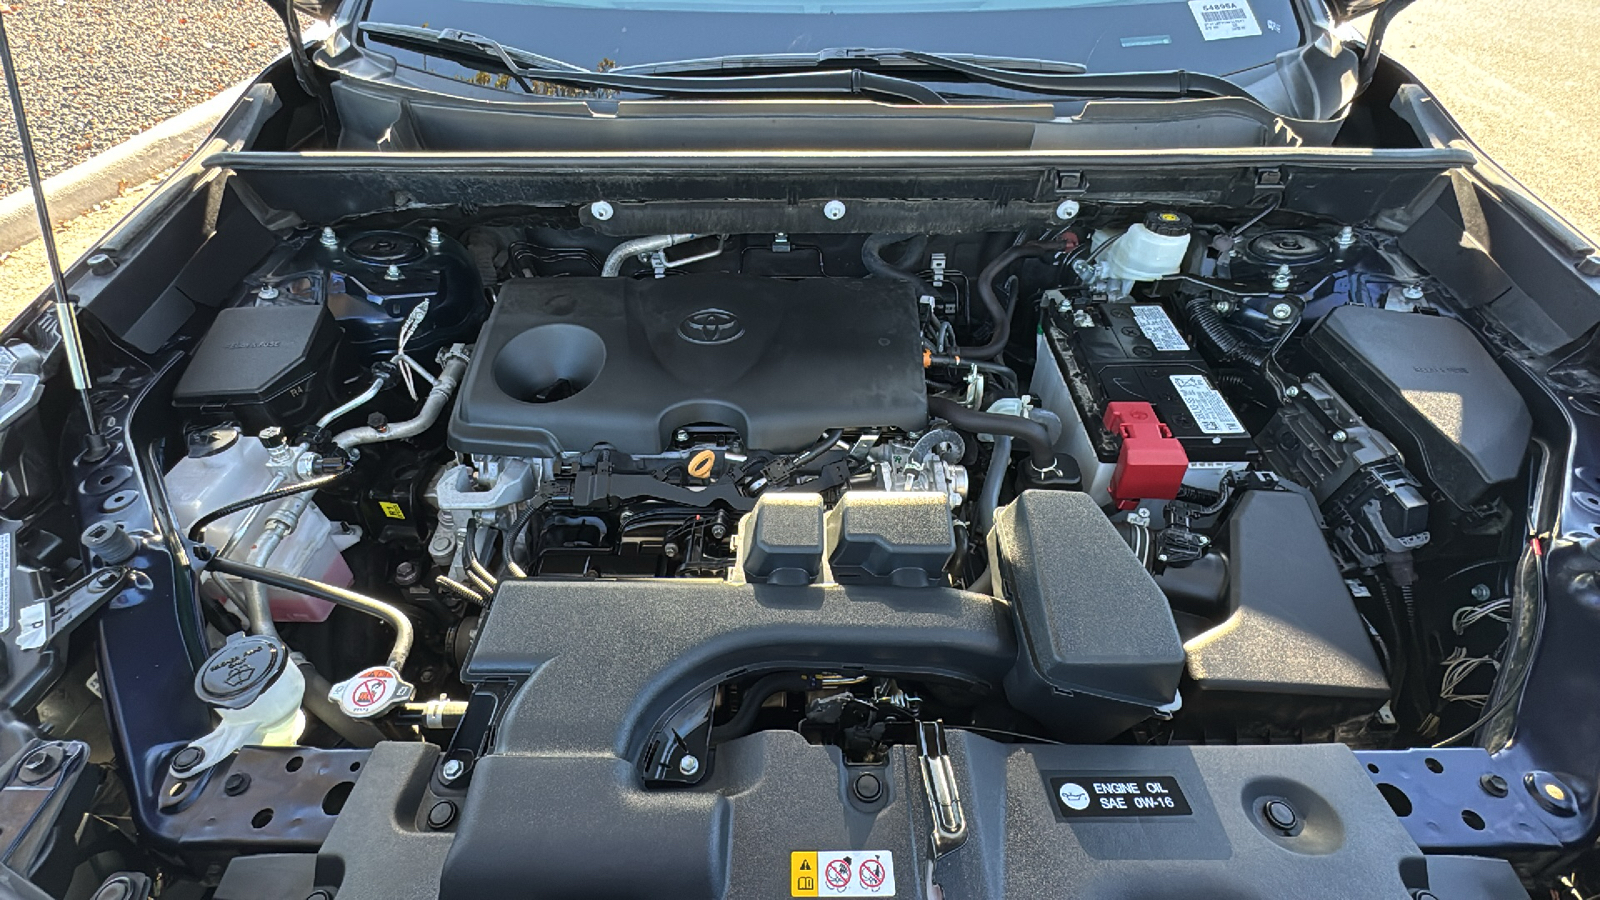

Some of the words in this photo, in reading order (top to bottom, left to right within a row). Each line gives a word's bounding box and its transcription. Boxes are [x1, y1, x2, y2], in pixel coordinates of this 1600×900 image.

[289, 386, 303, 398] R4
[1093, 782, 1140, 794] ENGINE
[1146, 782, 1168, 794] OIL
[1100, 797, 1127, 809] SAE
[1133, 796, 1174, 808] 0W-16
